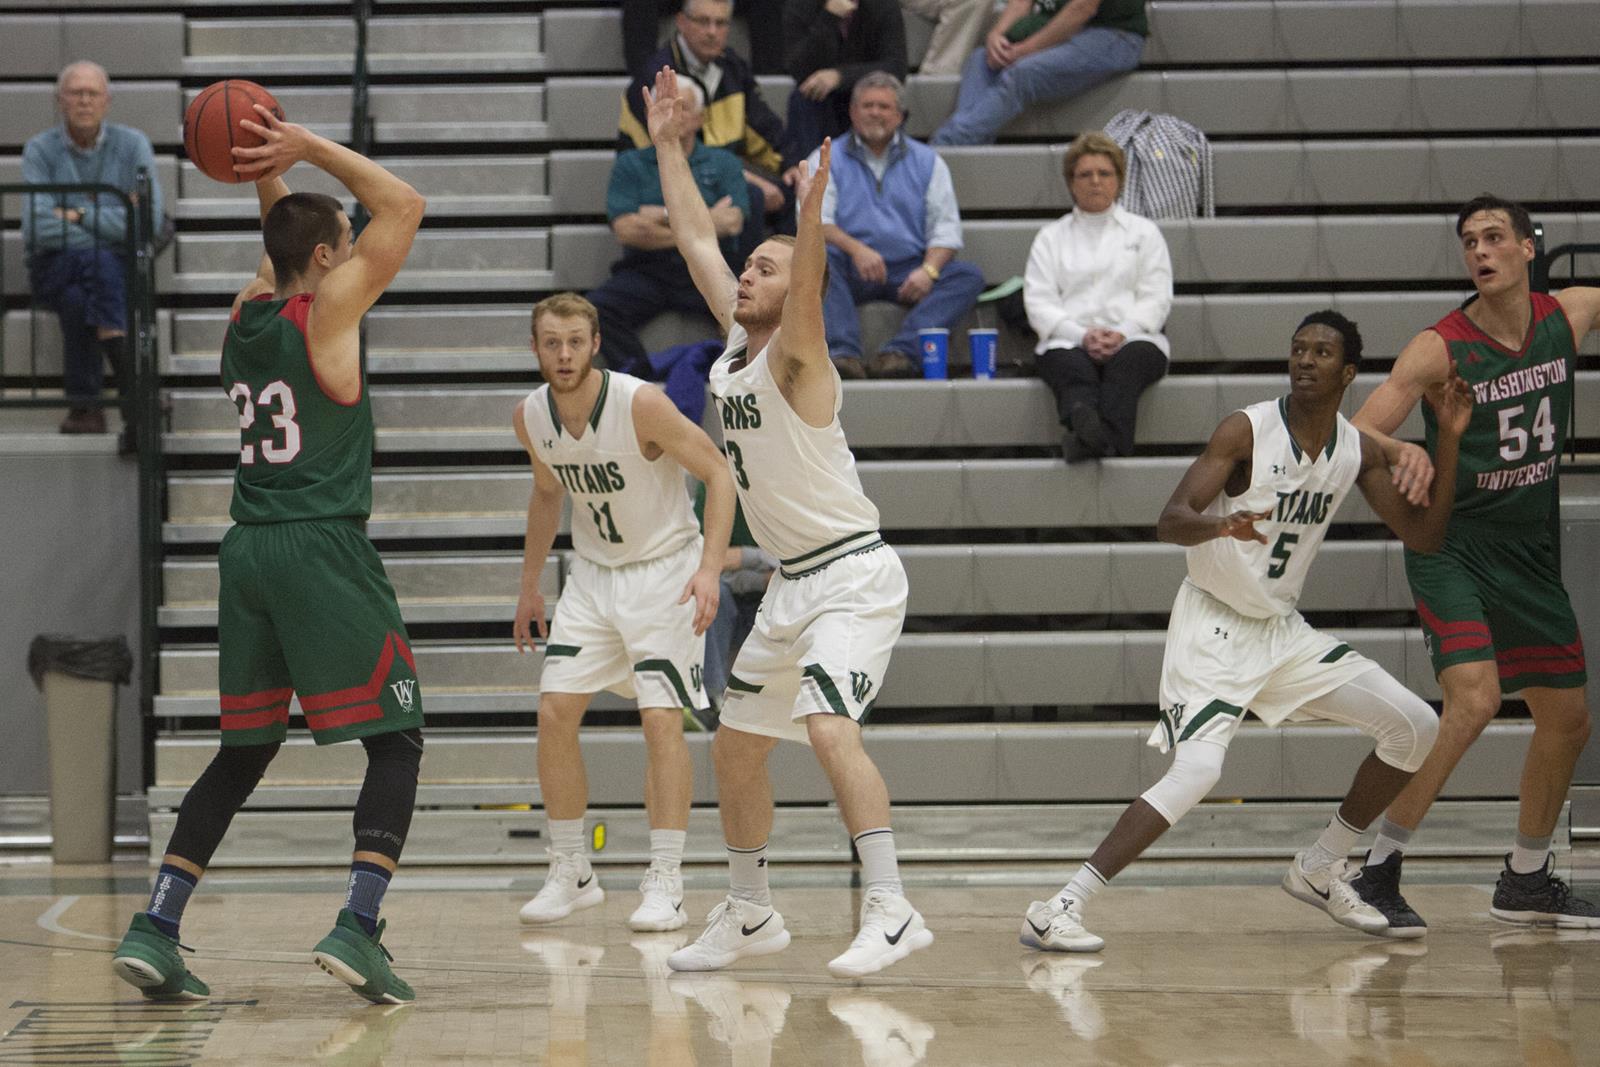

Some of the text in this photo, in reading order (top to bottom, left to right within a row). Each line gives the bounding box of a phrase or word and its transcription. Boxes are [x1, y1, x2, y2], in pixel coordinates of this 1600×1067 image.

[1472, 358, 1567, 405] WASHINGTON
[229, 380, 301, 464] 23
[1498, 396, 1556, 462] 54
[552, 461, 626, 494] TITANS
[1476, 454, 1557, 490] UNIVERSIT
[587, 501, 624, 544] 11
[1266, 489, 1334, 525] ITANS
[1267, 531, 1300, 579] 5
